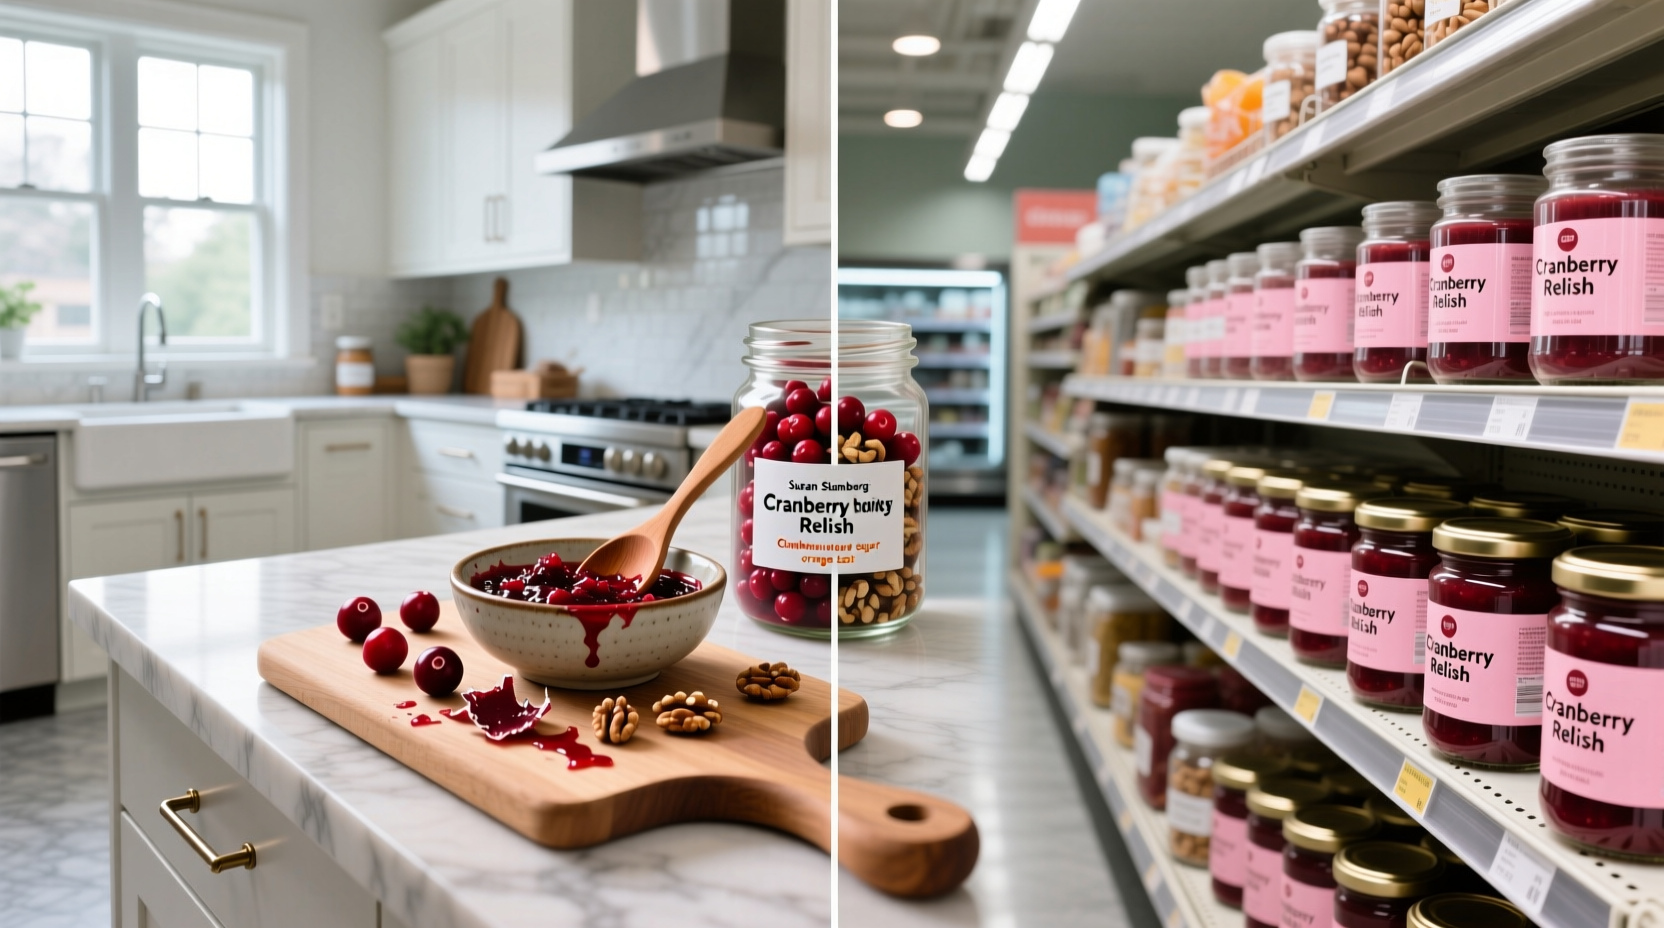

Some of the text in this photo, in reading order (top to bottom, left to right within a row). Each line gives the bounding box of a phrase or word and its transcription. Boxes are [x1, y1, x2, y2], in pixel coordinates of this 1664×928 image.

[1536, 255, 1618, 276] Cranberry
[1544, 276, 1594, 296] Relish
[764, 493, 850, 518] Cranberry
[800, 517, 854, 534] Relish
[1426, 634, 1494, 669] Cranberry
[1430, 657, 1470, 682] Relish
[1546, 690, 1635, 736] Cranberry
[1552, 720, 1604, 753] Relish
